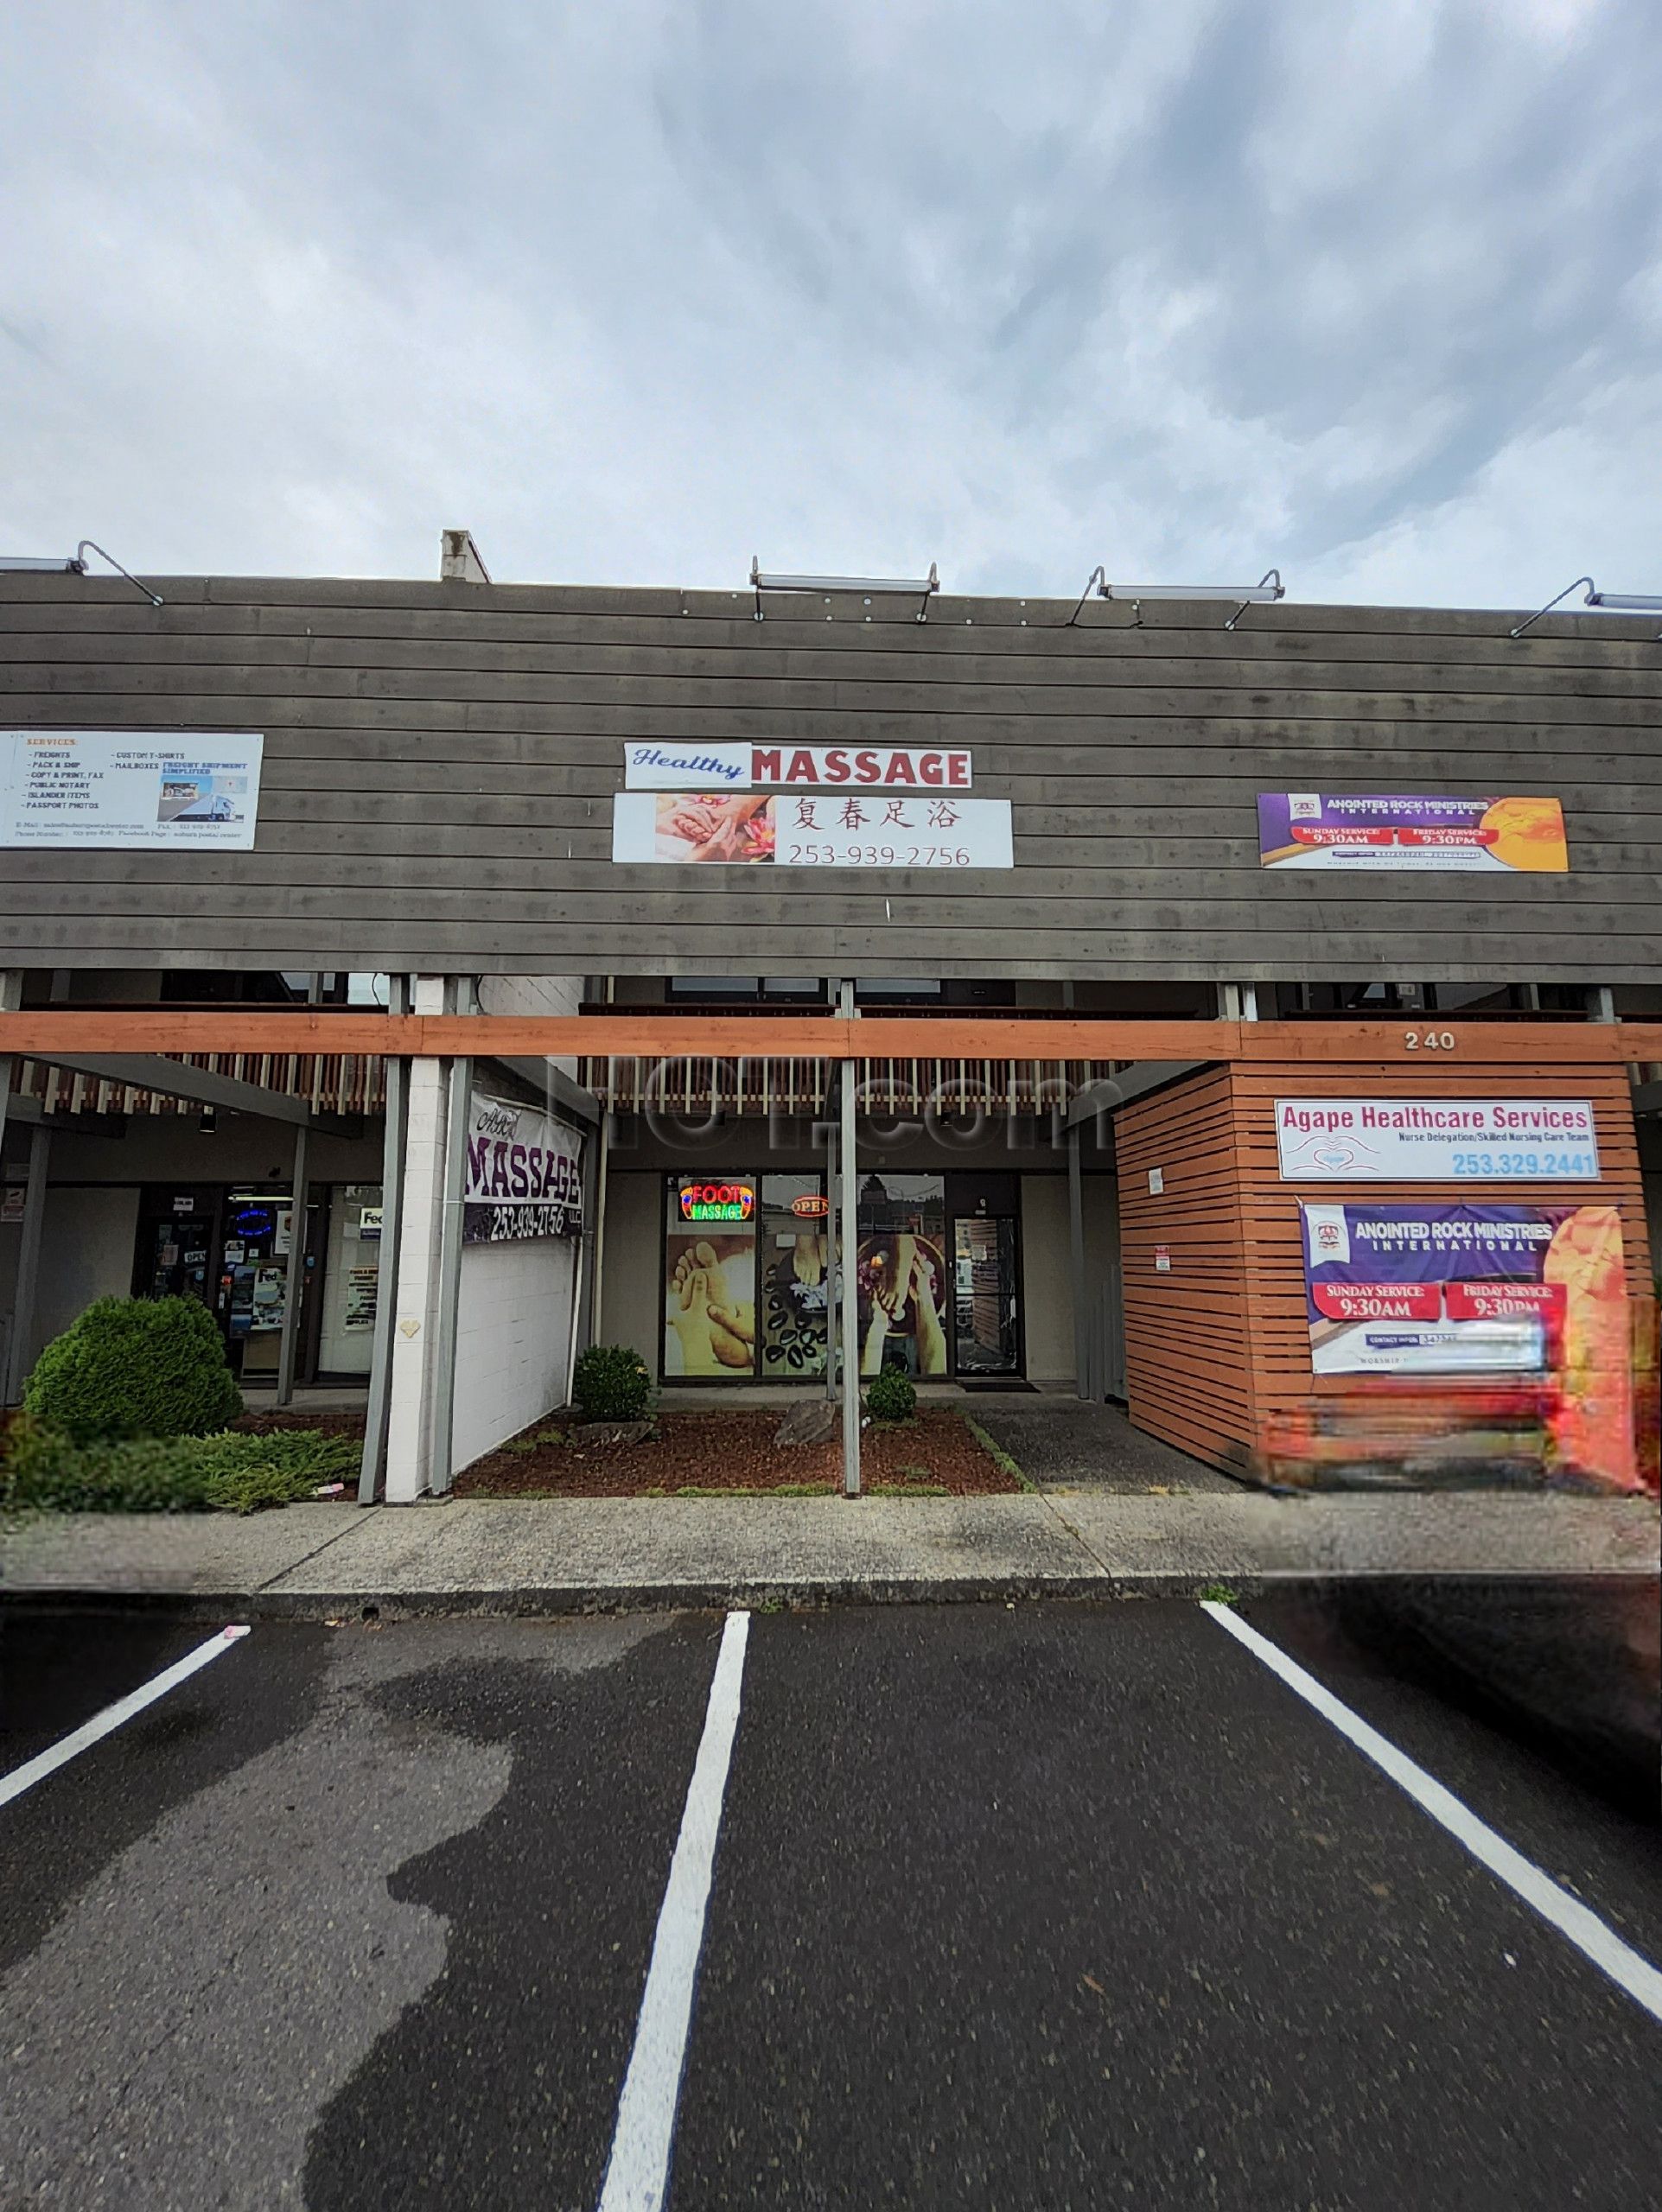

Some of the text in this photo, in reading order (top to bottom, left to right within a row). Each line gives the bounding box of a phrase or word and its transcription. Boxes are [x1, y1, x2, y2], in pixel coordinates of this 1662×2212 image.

[633, 748, 969, 786] Healthy MASSAGE
[1327, 799, 1489, 810] ANOINTED ROCK MINISTRIES
[791, 797, 962, 831] 复春足浴
[1313, 834, 1369, 844] 9:30AM
[1422, 835, 1477, 845] 9:30PM
[788, 843, 971, 867] 253-939-2756
[1404, 1031, 1455, 1051] 240
[1283, 1106, 1589, 1132] Agape Healthcare Services
[1398, 1132, 1425, 1141] Nurse
[1509, 1132, 1543, 1143] Nursing
[1544, 1132, 1564, 1141] Care
[1566, 1132, 1589, 1141] Team
[464, 1134, 583, 1205] MASSAGE
[1452, 1154, 1594, 1175] 253.329.2441
[692, 1185, 742, 1204] FOOT
[692, 1204, 742, 1220] MASSAGE
[792, 1200, 829, 1212] OPEN
[490, 1206, 564, 1241] 253-939-2756
[1355, 1222, 1553, 1241] ANOINTED ROCK MINISTRIES
[1372, 1241, 1537, 1251] INTERNATIONAL
[1327, 1285, 1373, 1297] SUNDAY
[1463, 1285, 1503, 1297] FRIDAY
[1340, 1299, 1412, 1317] 9:30AM
[1474, 1299, 1541, 1316] 9:30PM
